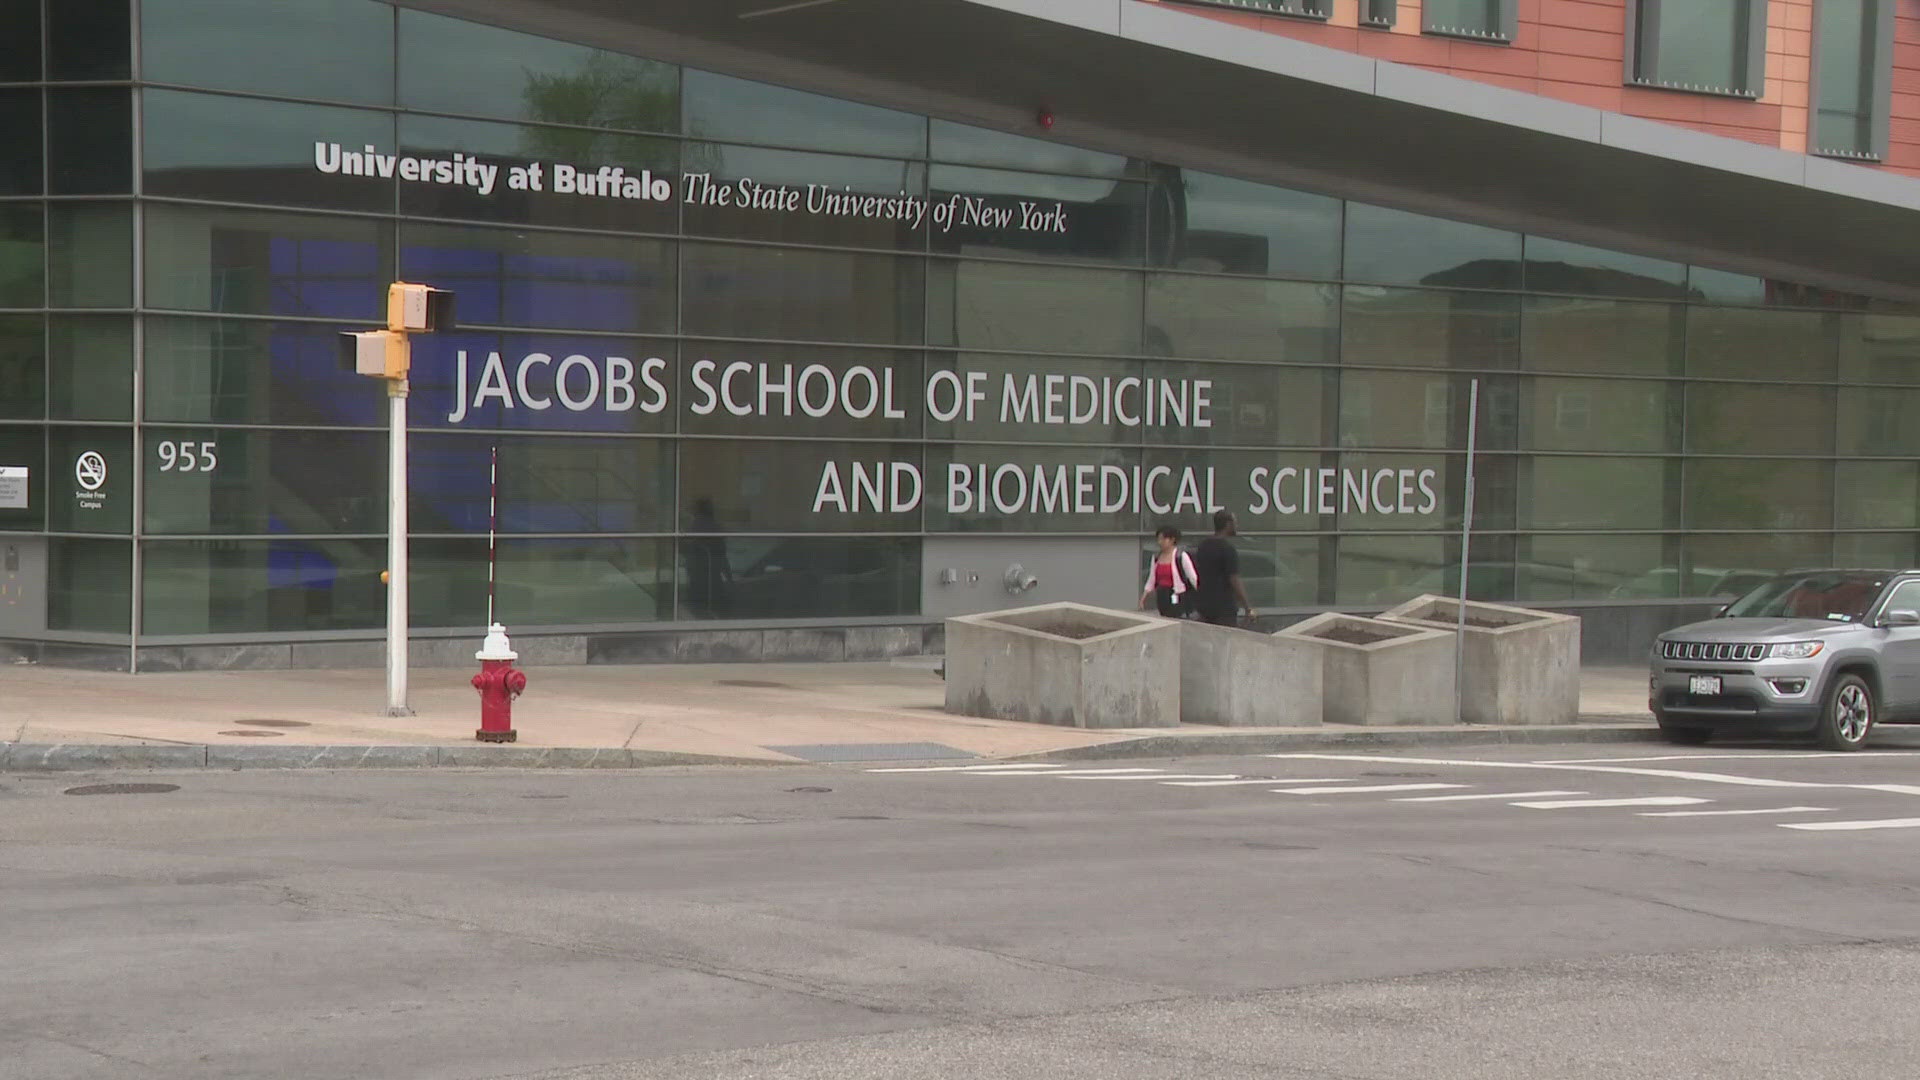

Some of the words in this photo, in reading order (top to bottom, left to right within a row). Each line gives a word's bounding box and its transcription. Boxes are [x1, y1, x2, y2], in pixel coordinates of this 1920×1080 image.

[315, 142, 499, 196] University
[508, 162, 543, 191] at
[553, 164, 671, 201] Buffalo
[682, 172, 731, 207] The
[735, 177, 800, 212] State
[806, 183, 928, 230] University
[933, 194, 961, 232] of
[960, 197, 1013, 229] New
[1018, 201, 1068, 233] York
[448, 350, 668, 424] JACOBS
[690, 359, 906, 419] SCHOOL
[926, 369, 989, 422] OF
[1000, 373, 1213, 428] MEDICINE
[157, 440, 218, 472] 955
[75, 491, 93, 499] Smoke
[94, 491, 106, 499] Free
[80, 500, 102, 509] Campus
[812, 461, 922, 514] AND
[947, 462, 1226, 515] BIOMEDICAL
[1248, 465, 1437, 516] SCIENCES
